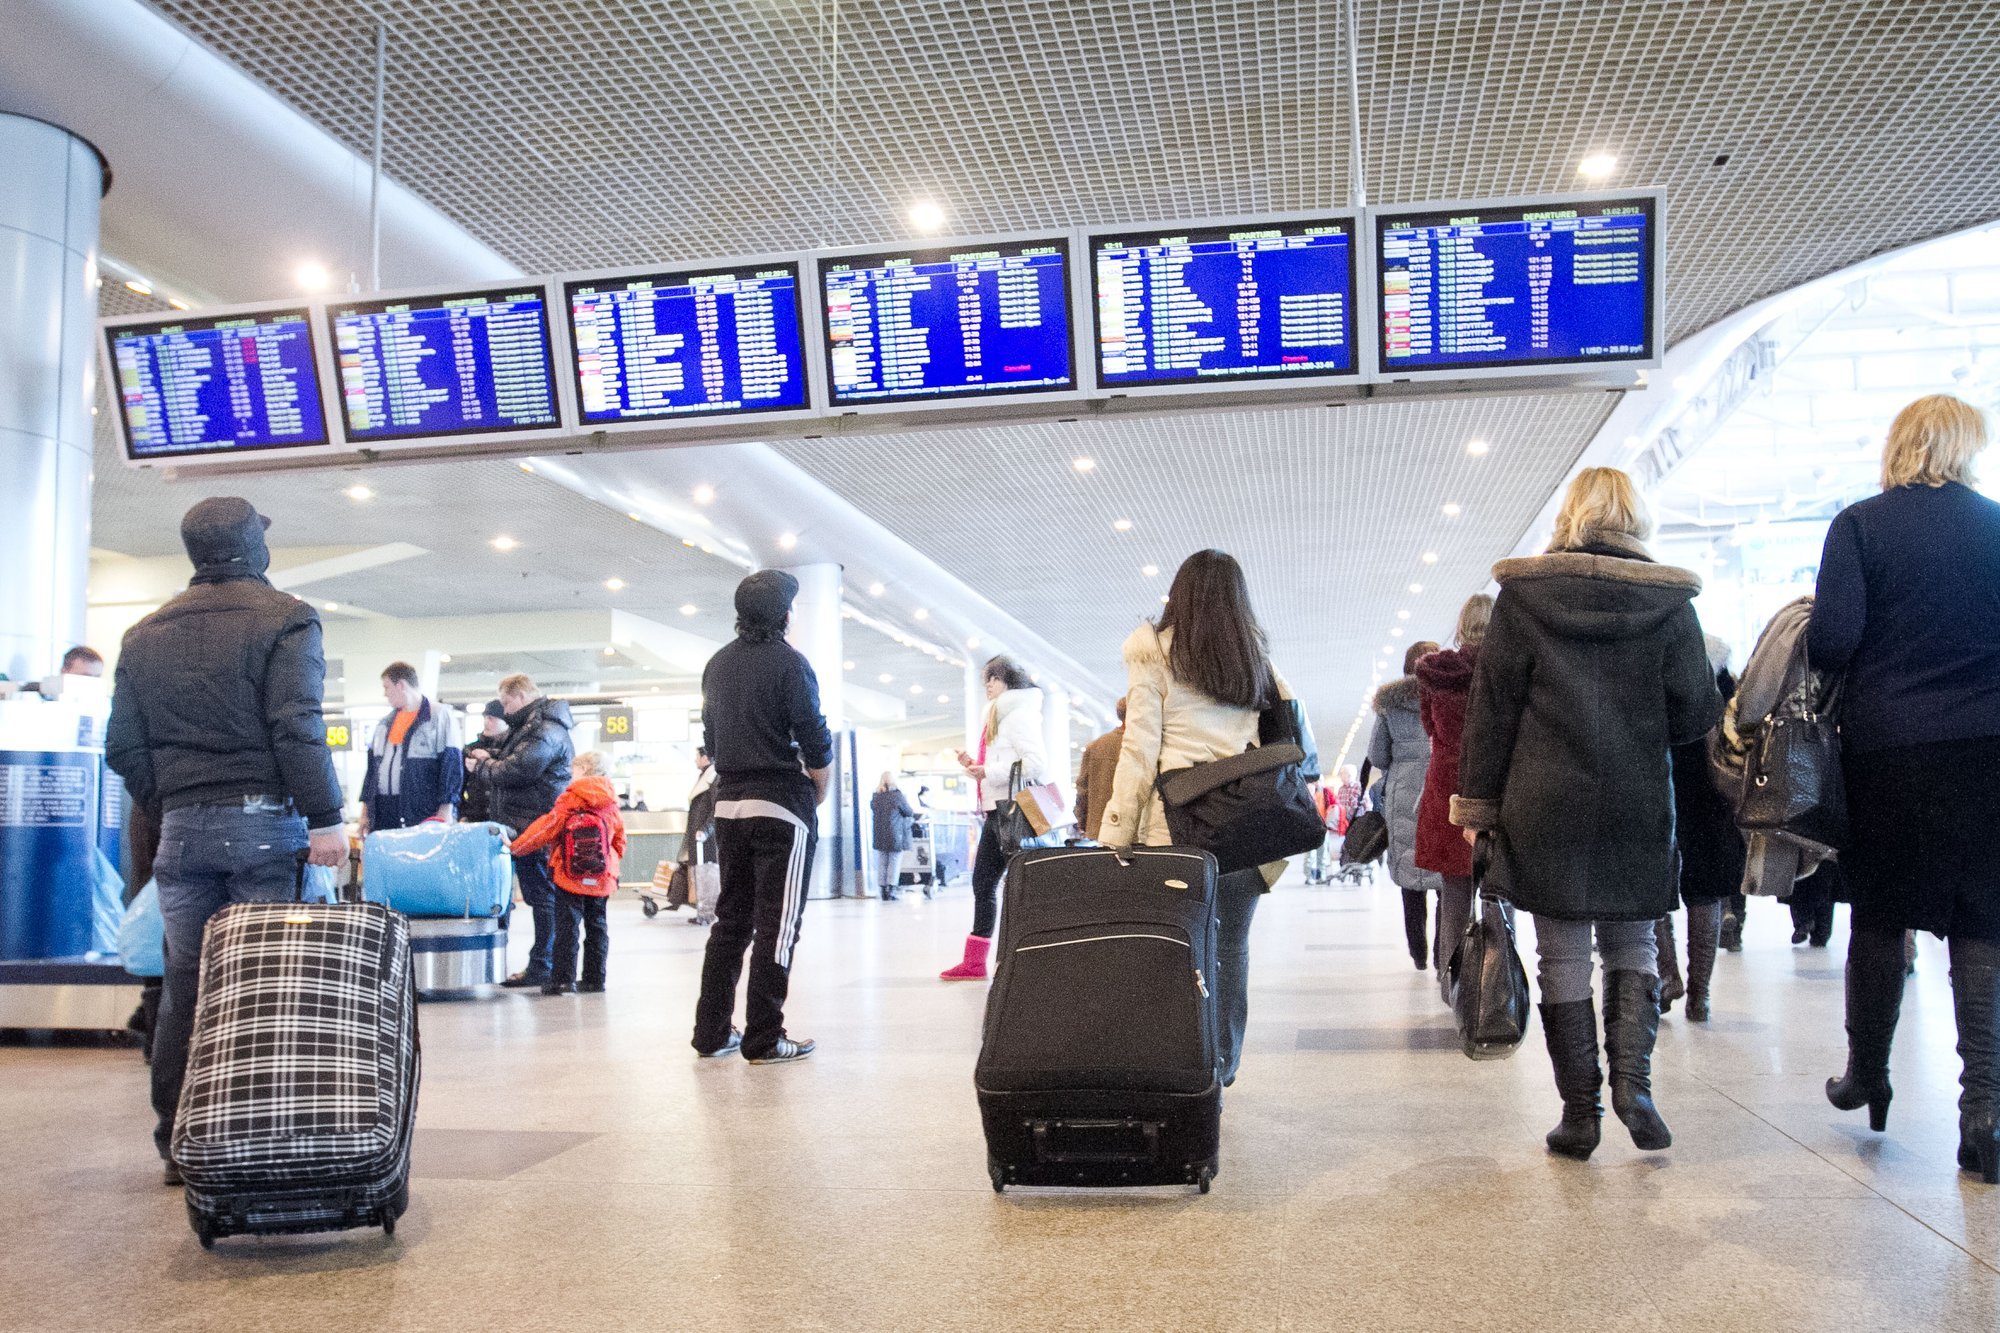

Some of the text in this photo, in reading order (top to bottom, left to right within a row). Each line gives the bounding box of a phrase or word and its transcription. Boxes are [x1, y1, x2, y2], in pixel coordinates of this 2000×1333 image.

[1523, 211, 1577, 220] DEPARTURES
[1603, 207, 1639, 215] 13.02.2012
[1230, 231, 1281, 240] DEPARTURES
[950, 252, 999, 261] DEPARTURES
[606, 716, 628, 734] 58
